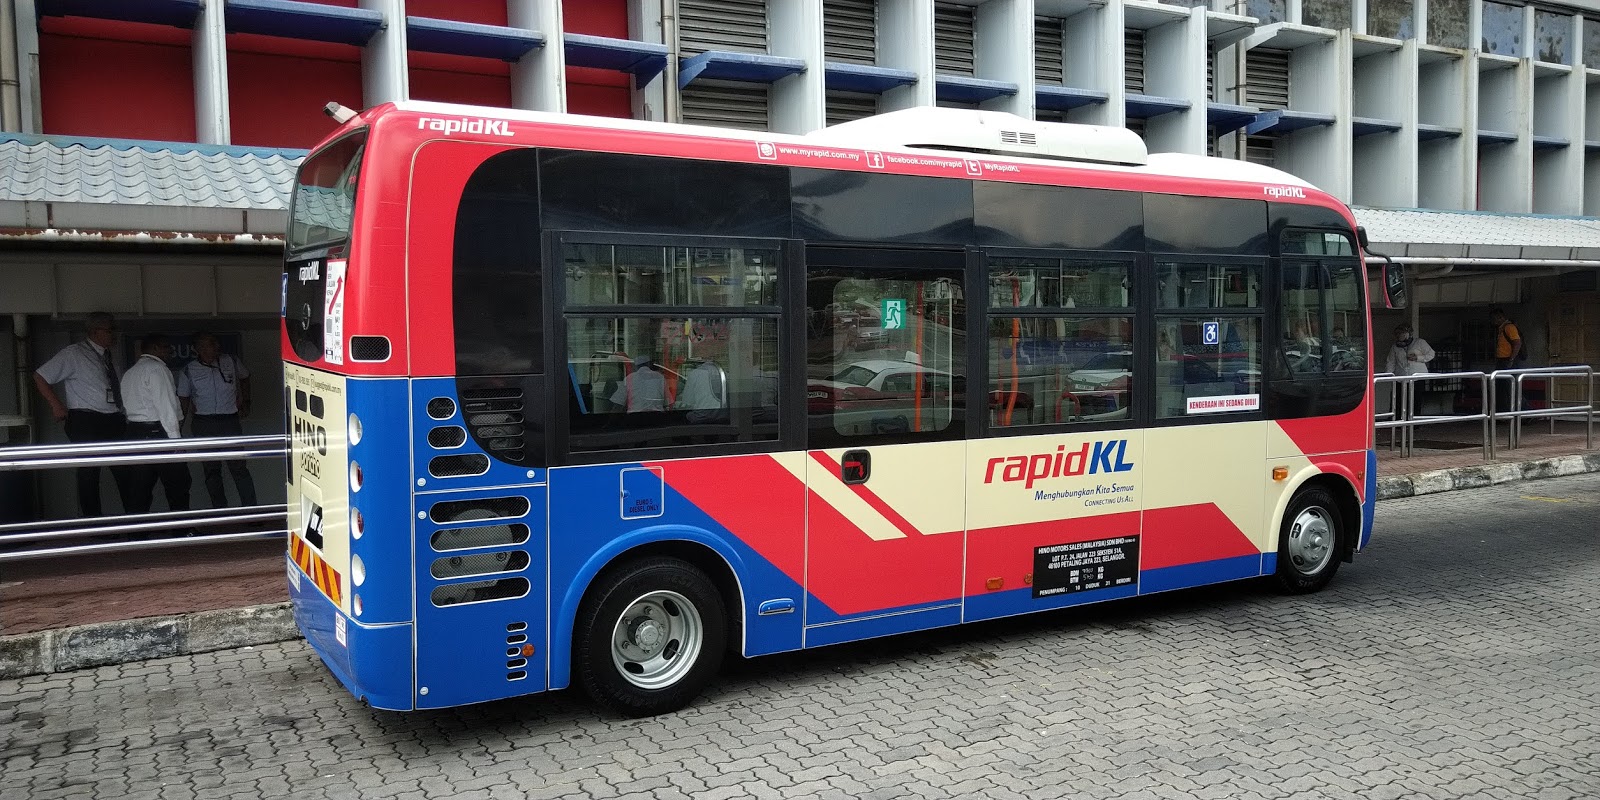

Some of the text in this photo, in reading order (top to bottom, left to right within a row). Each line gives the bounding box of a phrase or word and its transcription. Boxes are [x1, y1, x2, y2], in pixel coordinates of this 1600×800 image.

[418, 117, 516, 137] rapidKL
[779, 146, 860, 162] www.myrapid.com.my
[887, 154, 963, 171] facebook.com/myrapid
[1263, 186, 1306, 198] rapidKL
[298, 260, 320, 286] rapidKL
[1189, 400, 1218, 410] KENDERAAN
[1226, 399, 1244, 408] SEDANG
[294, 415, 327, 457] HINO
[984, 439, 1135, 490] rapidKL
[1034, 483, 1135, 502] Menghubungkan Kita Semua
[1038, 546, 1050, 554] HINO
[1050, 544, 1069, 553] MOTORS
[1069, 543, 1082, 551] SALES
[1081, 540, 1107, 550] (MALAYSIA)
[1061, 559, 1082, 568] PETALING
[1081, 557, 1094, 565] JAYA
[1075, 551, 1088, 560] JALAN
[1085, 582, 1100, 590] DUDUK
